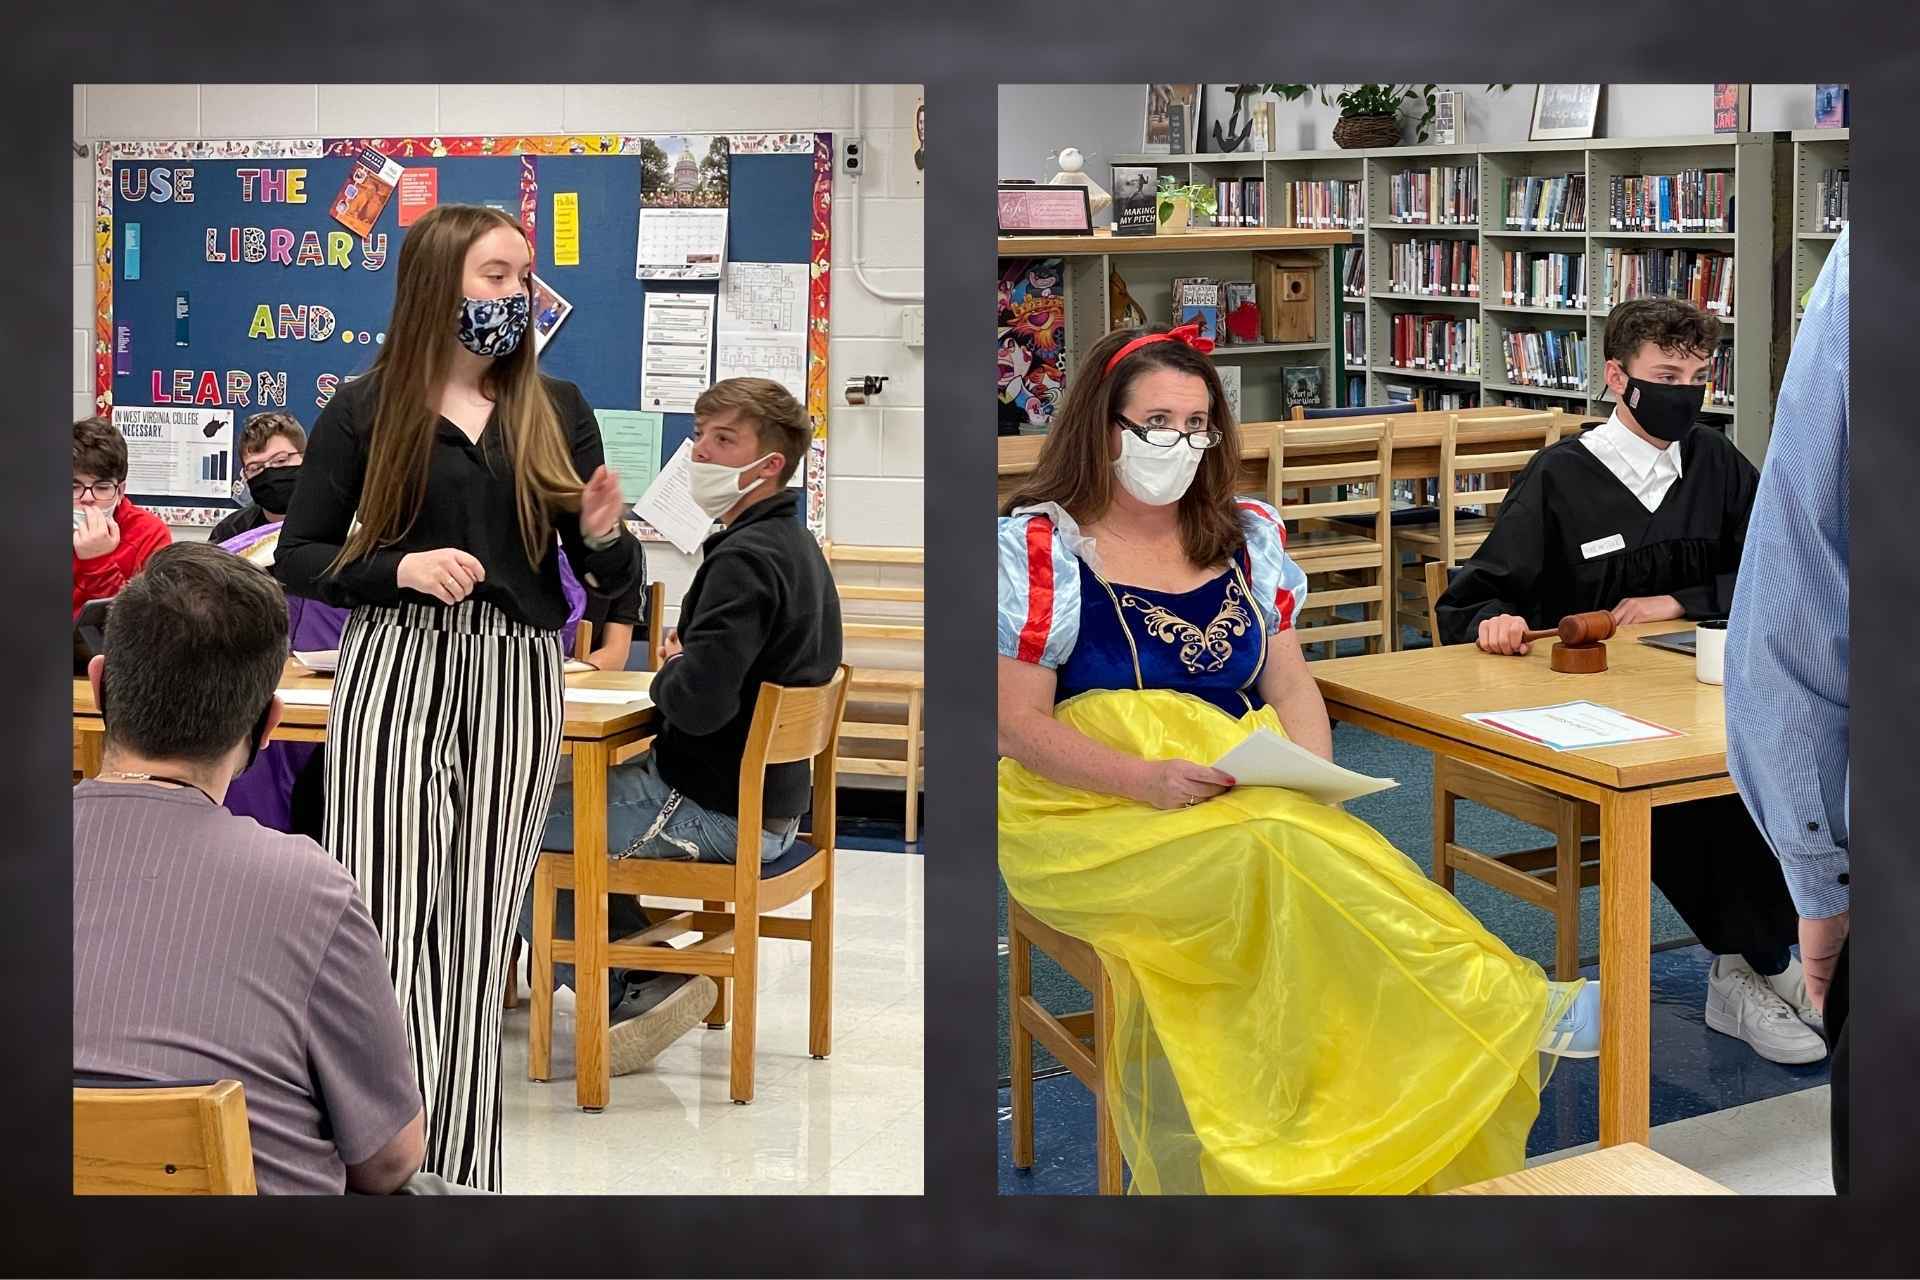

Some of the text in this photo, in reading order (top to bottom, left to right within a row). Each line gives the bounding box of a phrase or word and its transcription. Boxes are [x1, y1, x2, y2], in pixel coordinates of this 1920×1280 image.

[120, 168, 308, 204] USE THE
[1120, 214, 1156, 225] MY PITCH
[1124, 206, 1156, 216] MAKING
[206, 227, 388, 271] LIBRARY
[152, 370, 287, 408] LEARN
[114, 410, 122, 422] IN
[123, 411, 141, 423] WEST
[172, 412, 199, 425] COLLEGE
